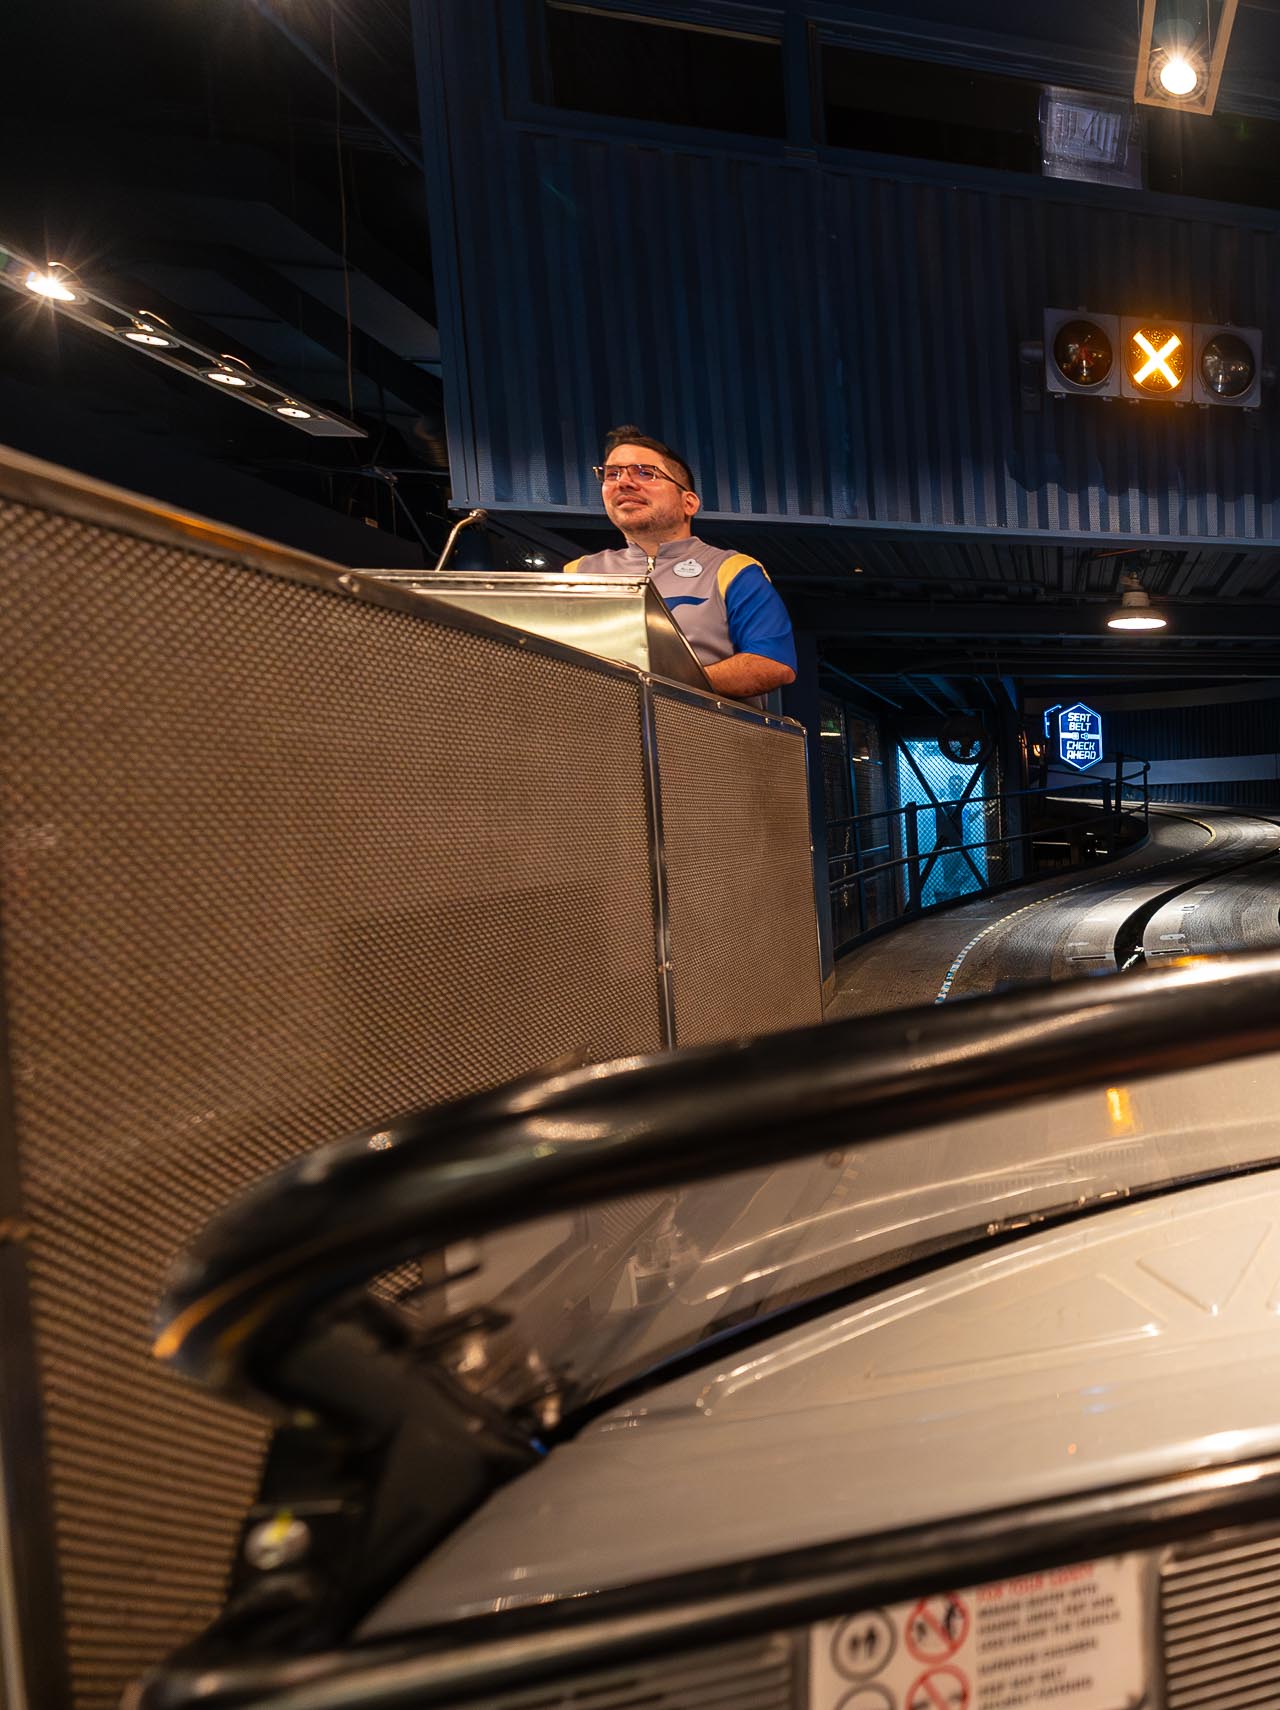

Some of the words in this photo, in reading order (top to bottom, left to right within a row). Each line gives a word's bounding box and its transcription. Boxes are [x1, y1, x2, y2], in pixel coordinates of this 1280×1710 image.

[1068, 712, 1091, 722] SEAT
[1069, 722, 1091, 731] BELT
[1067, 741, 1095, 750] CHECK
[1067, 750, 1096, 759] AHEAD
